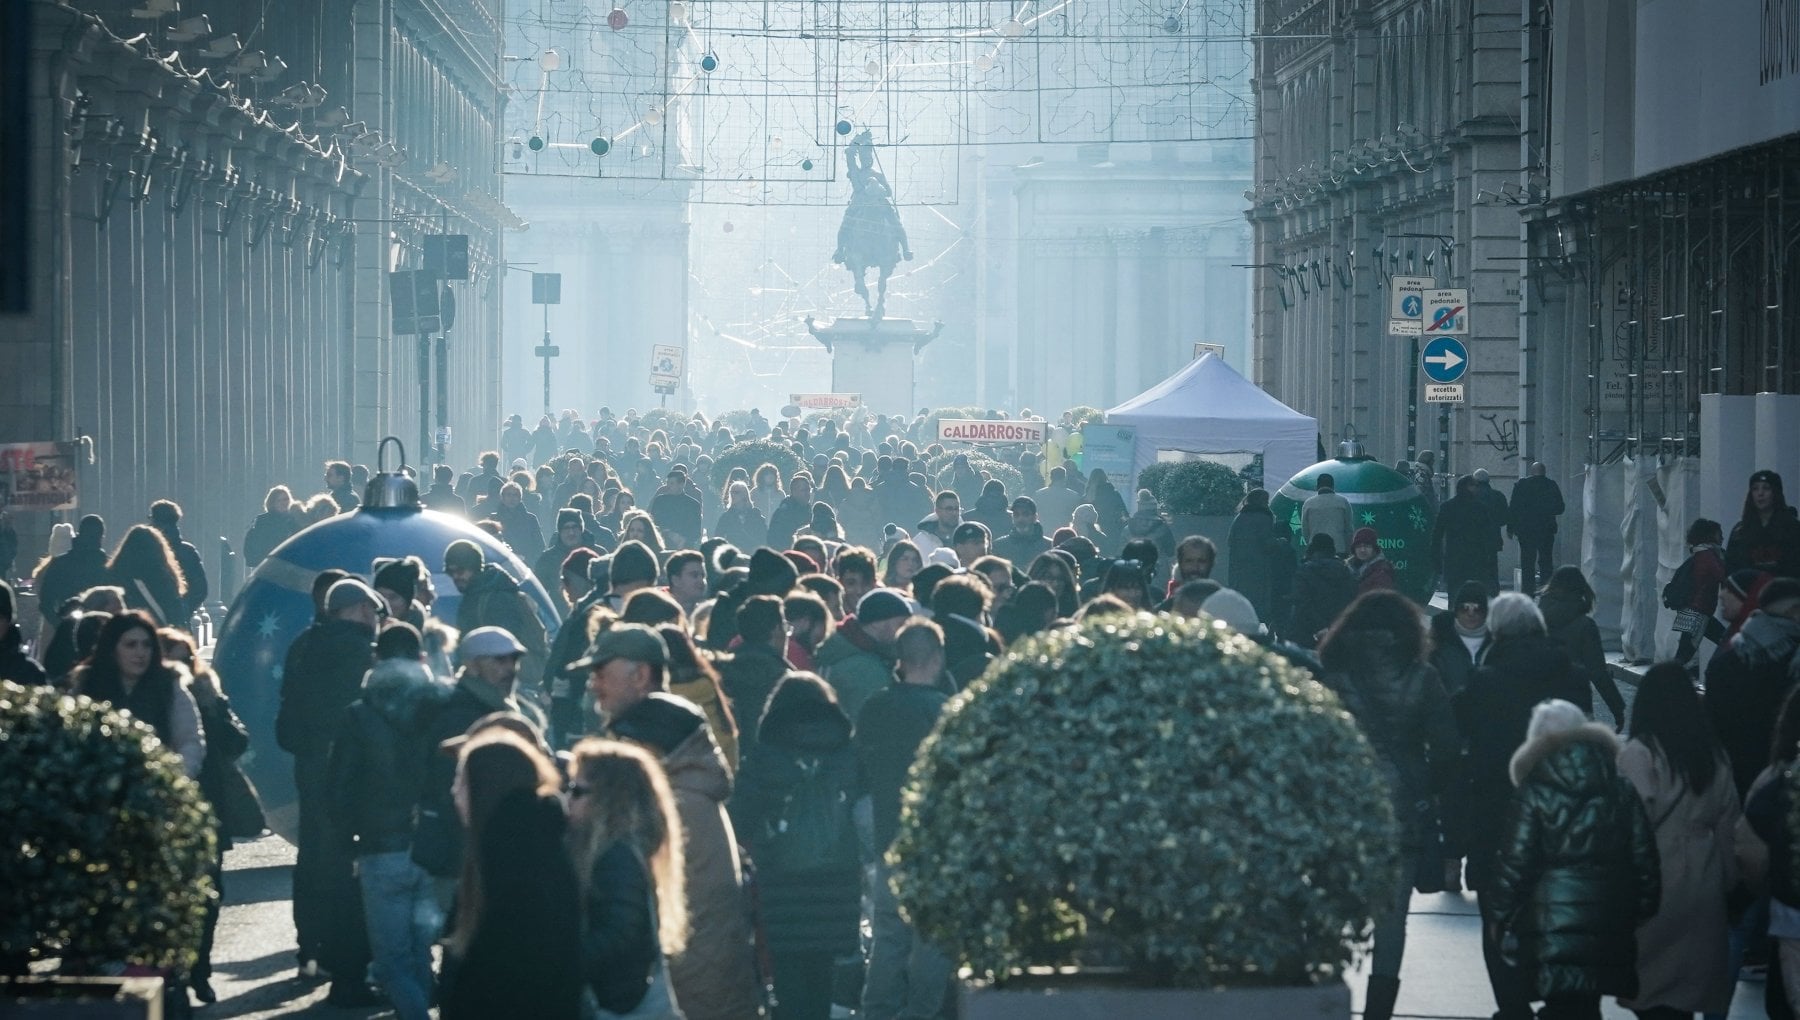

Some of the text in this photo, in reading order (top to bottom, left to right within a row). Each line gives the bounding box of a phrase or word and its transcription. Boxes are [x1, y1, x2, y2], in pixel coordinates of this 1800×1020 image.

[1428, 393, 1462, 401] autorizzati
[943, 424, 1041, 441] CALDARROSTE
[1377, 538, 1405, 549] RINO
